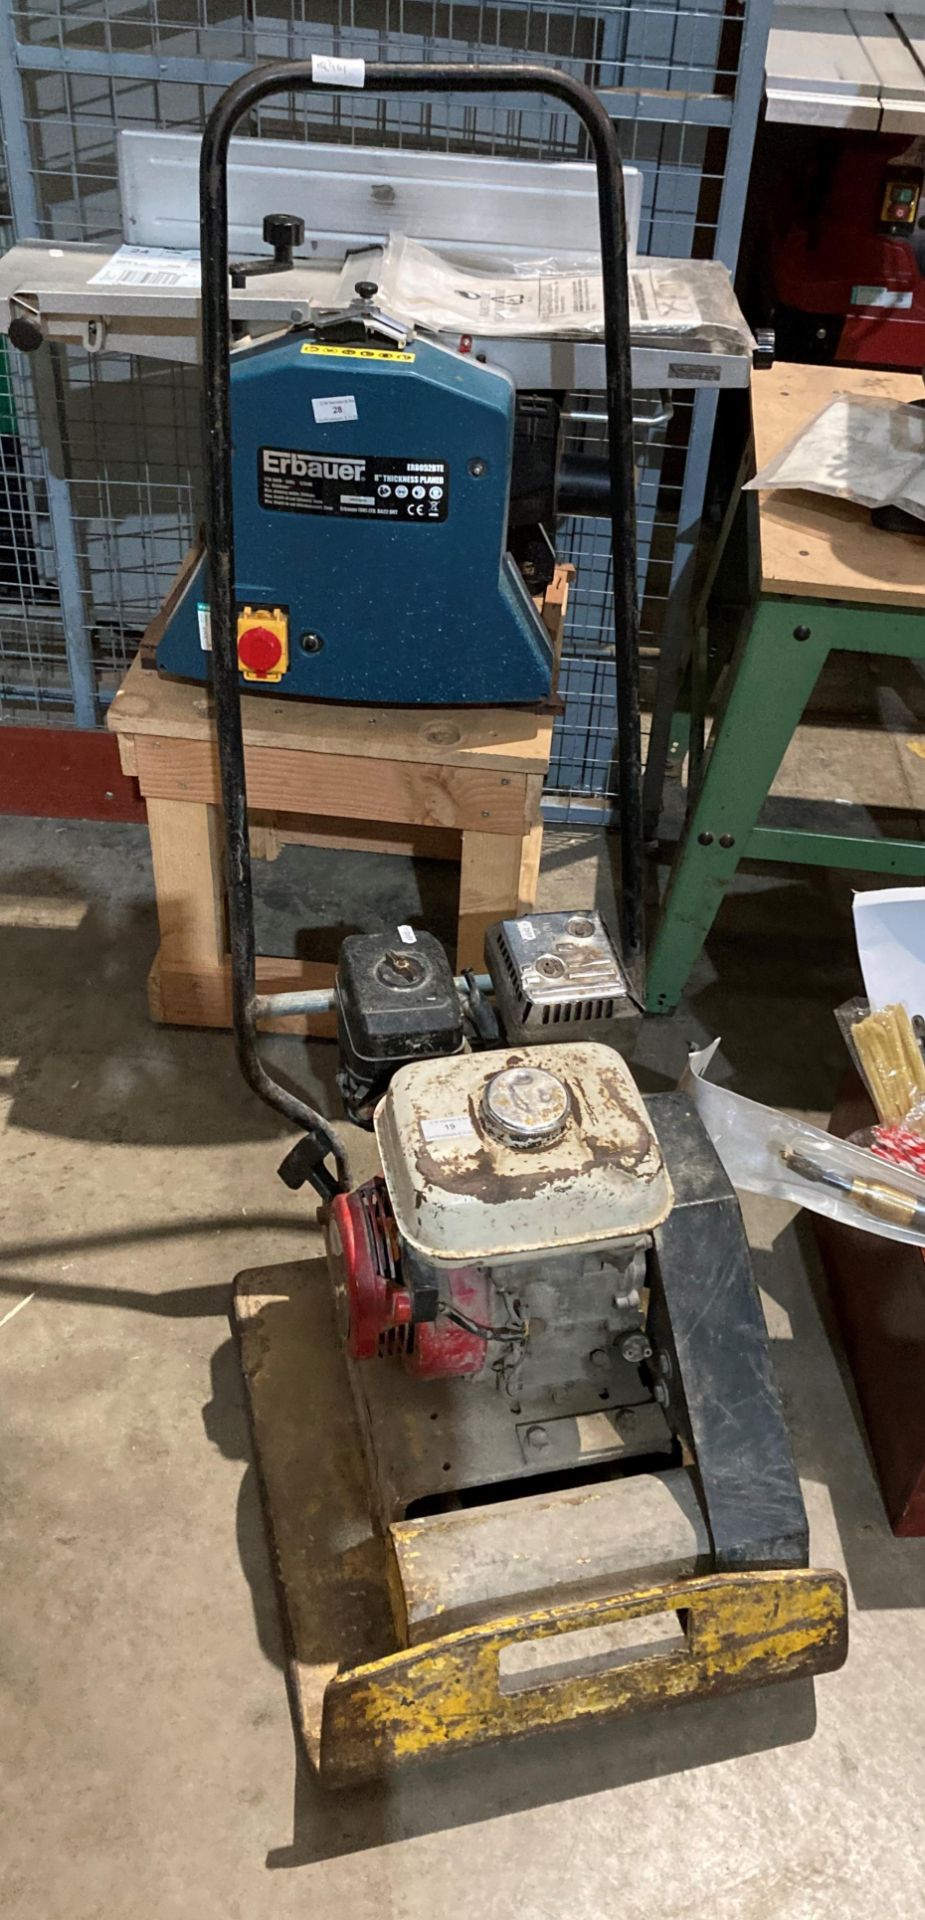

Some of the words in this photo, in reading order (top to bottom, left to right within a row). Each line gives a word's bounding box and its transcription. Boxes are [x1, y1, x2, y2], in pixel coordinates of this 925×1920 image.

[332, 406, 343, 414] 28
[263, 450, 366, 481] Erbauer
[383, 474, 419, 484] THICKNESS
[420, 476, 444, 485] PLANER
